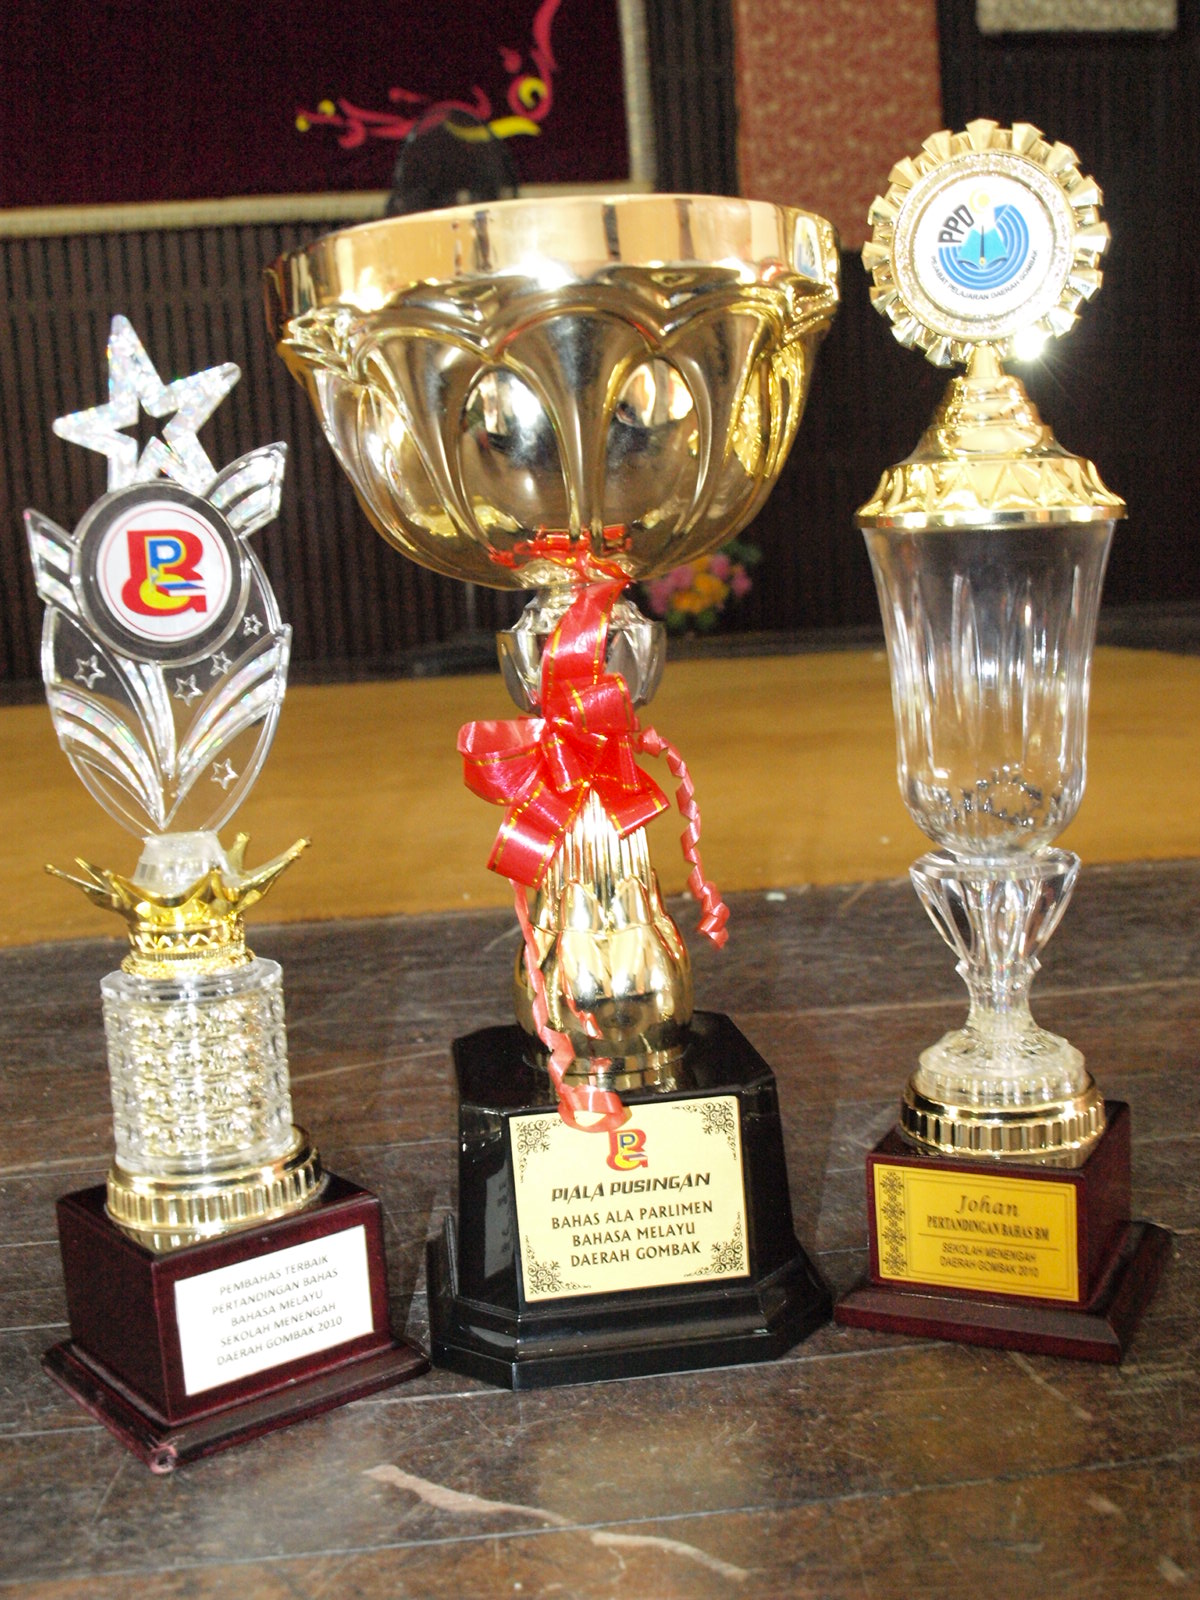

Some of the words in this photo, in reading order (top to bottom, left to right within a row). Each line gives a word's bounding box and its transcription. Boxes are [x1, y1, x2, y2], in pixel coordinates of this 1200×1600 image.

[937, 204, 975, 244] PPD
[551, 1182, 604, 1204] PIALA
[610, 1172, 711, 1196] PUSINGAN
[551, 1212, 600, 1230] BAHAS
[605, 1208, 634, 1223] ALA
[639, 1200, 713, 1220] PARLIMEN
[954, 1194, 1018, 1217] Johan
[572, 1230, 631, 1247] BAHASA
[636, 1222, 696, 1240] MELAYU
[926, 1215, 1000, 1235] PERTANDINGAN
[1002, 1223, 1033, 1239] BAHAS
[570, 1249, 630, 1267] DAERAH
[635, 1240, 701, 1260] GOMBAK
[940, 1255, 976, 1269] DAERAH
[942, 1242, 983, 1256] SEKOLAH
[985, 1247, 1037, 1263] MENENGAH
[219, 1269, 282, 1296] PEMBAHAS
[285, 1255, 329, 1276] TERBAIK
[212, 1281, 300, 1315] PERTANDINGAN
[303, 1269, 339, 1287] BAHAS
[231, 1306, 276, 1327] BAHASA
[279, 1290, 324, 1311] MELAYU
[220, 1324, 270, 1347] SEKOLAH
[273, 1302, 336, 1329] MENENGAH
[217, 1344, 263, 1366] DAERAH
[266, 1326, 316, 1350] GOMBAK
[318, 1316, 343, 1332] 2010
